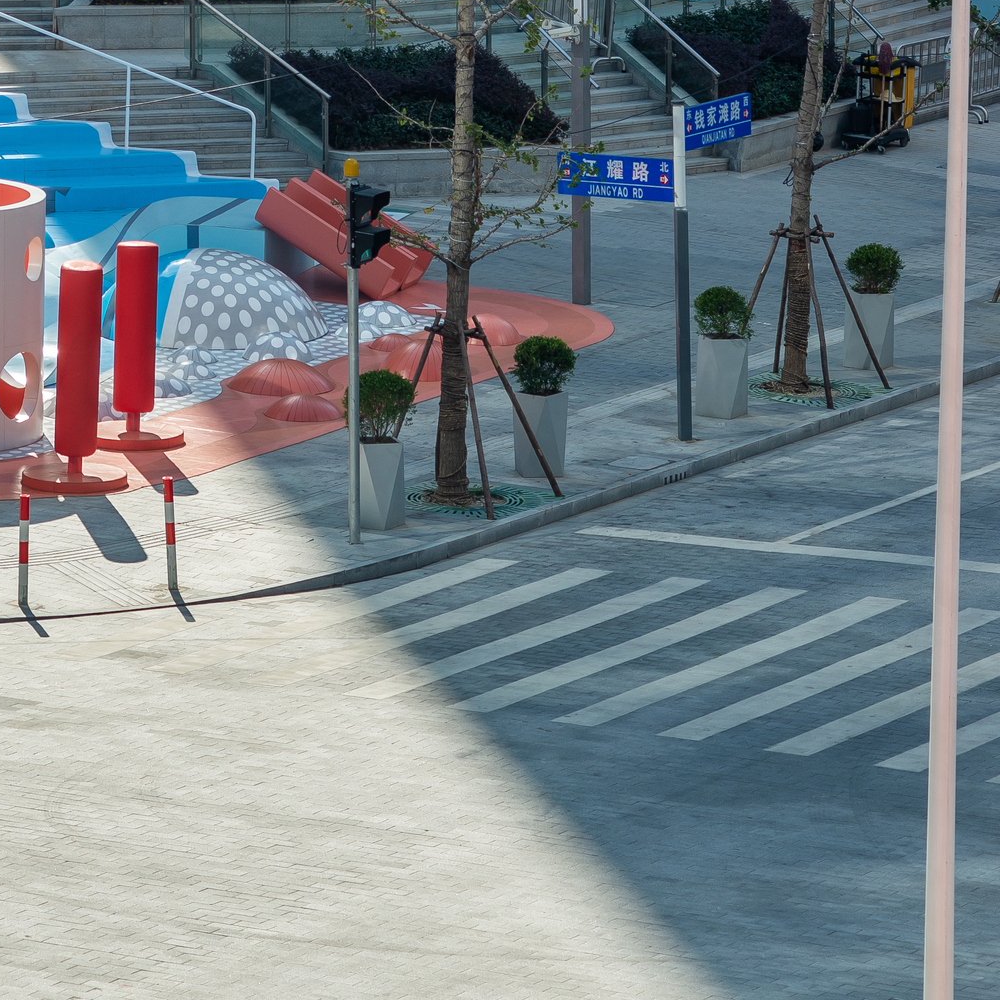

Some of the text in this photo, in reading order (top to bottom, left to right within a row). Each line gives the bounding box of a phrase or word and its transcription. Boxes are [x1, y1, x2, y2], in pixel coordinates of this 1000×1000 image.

[685, 95, 749, 130] 东 钱家滩路 西
[702, 127, 736, 145] QIANJIATAN RD
[660, 161, 669, 173] 北
[587, 184, 644, 199] JIANGYAO RD
